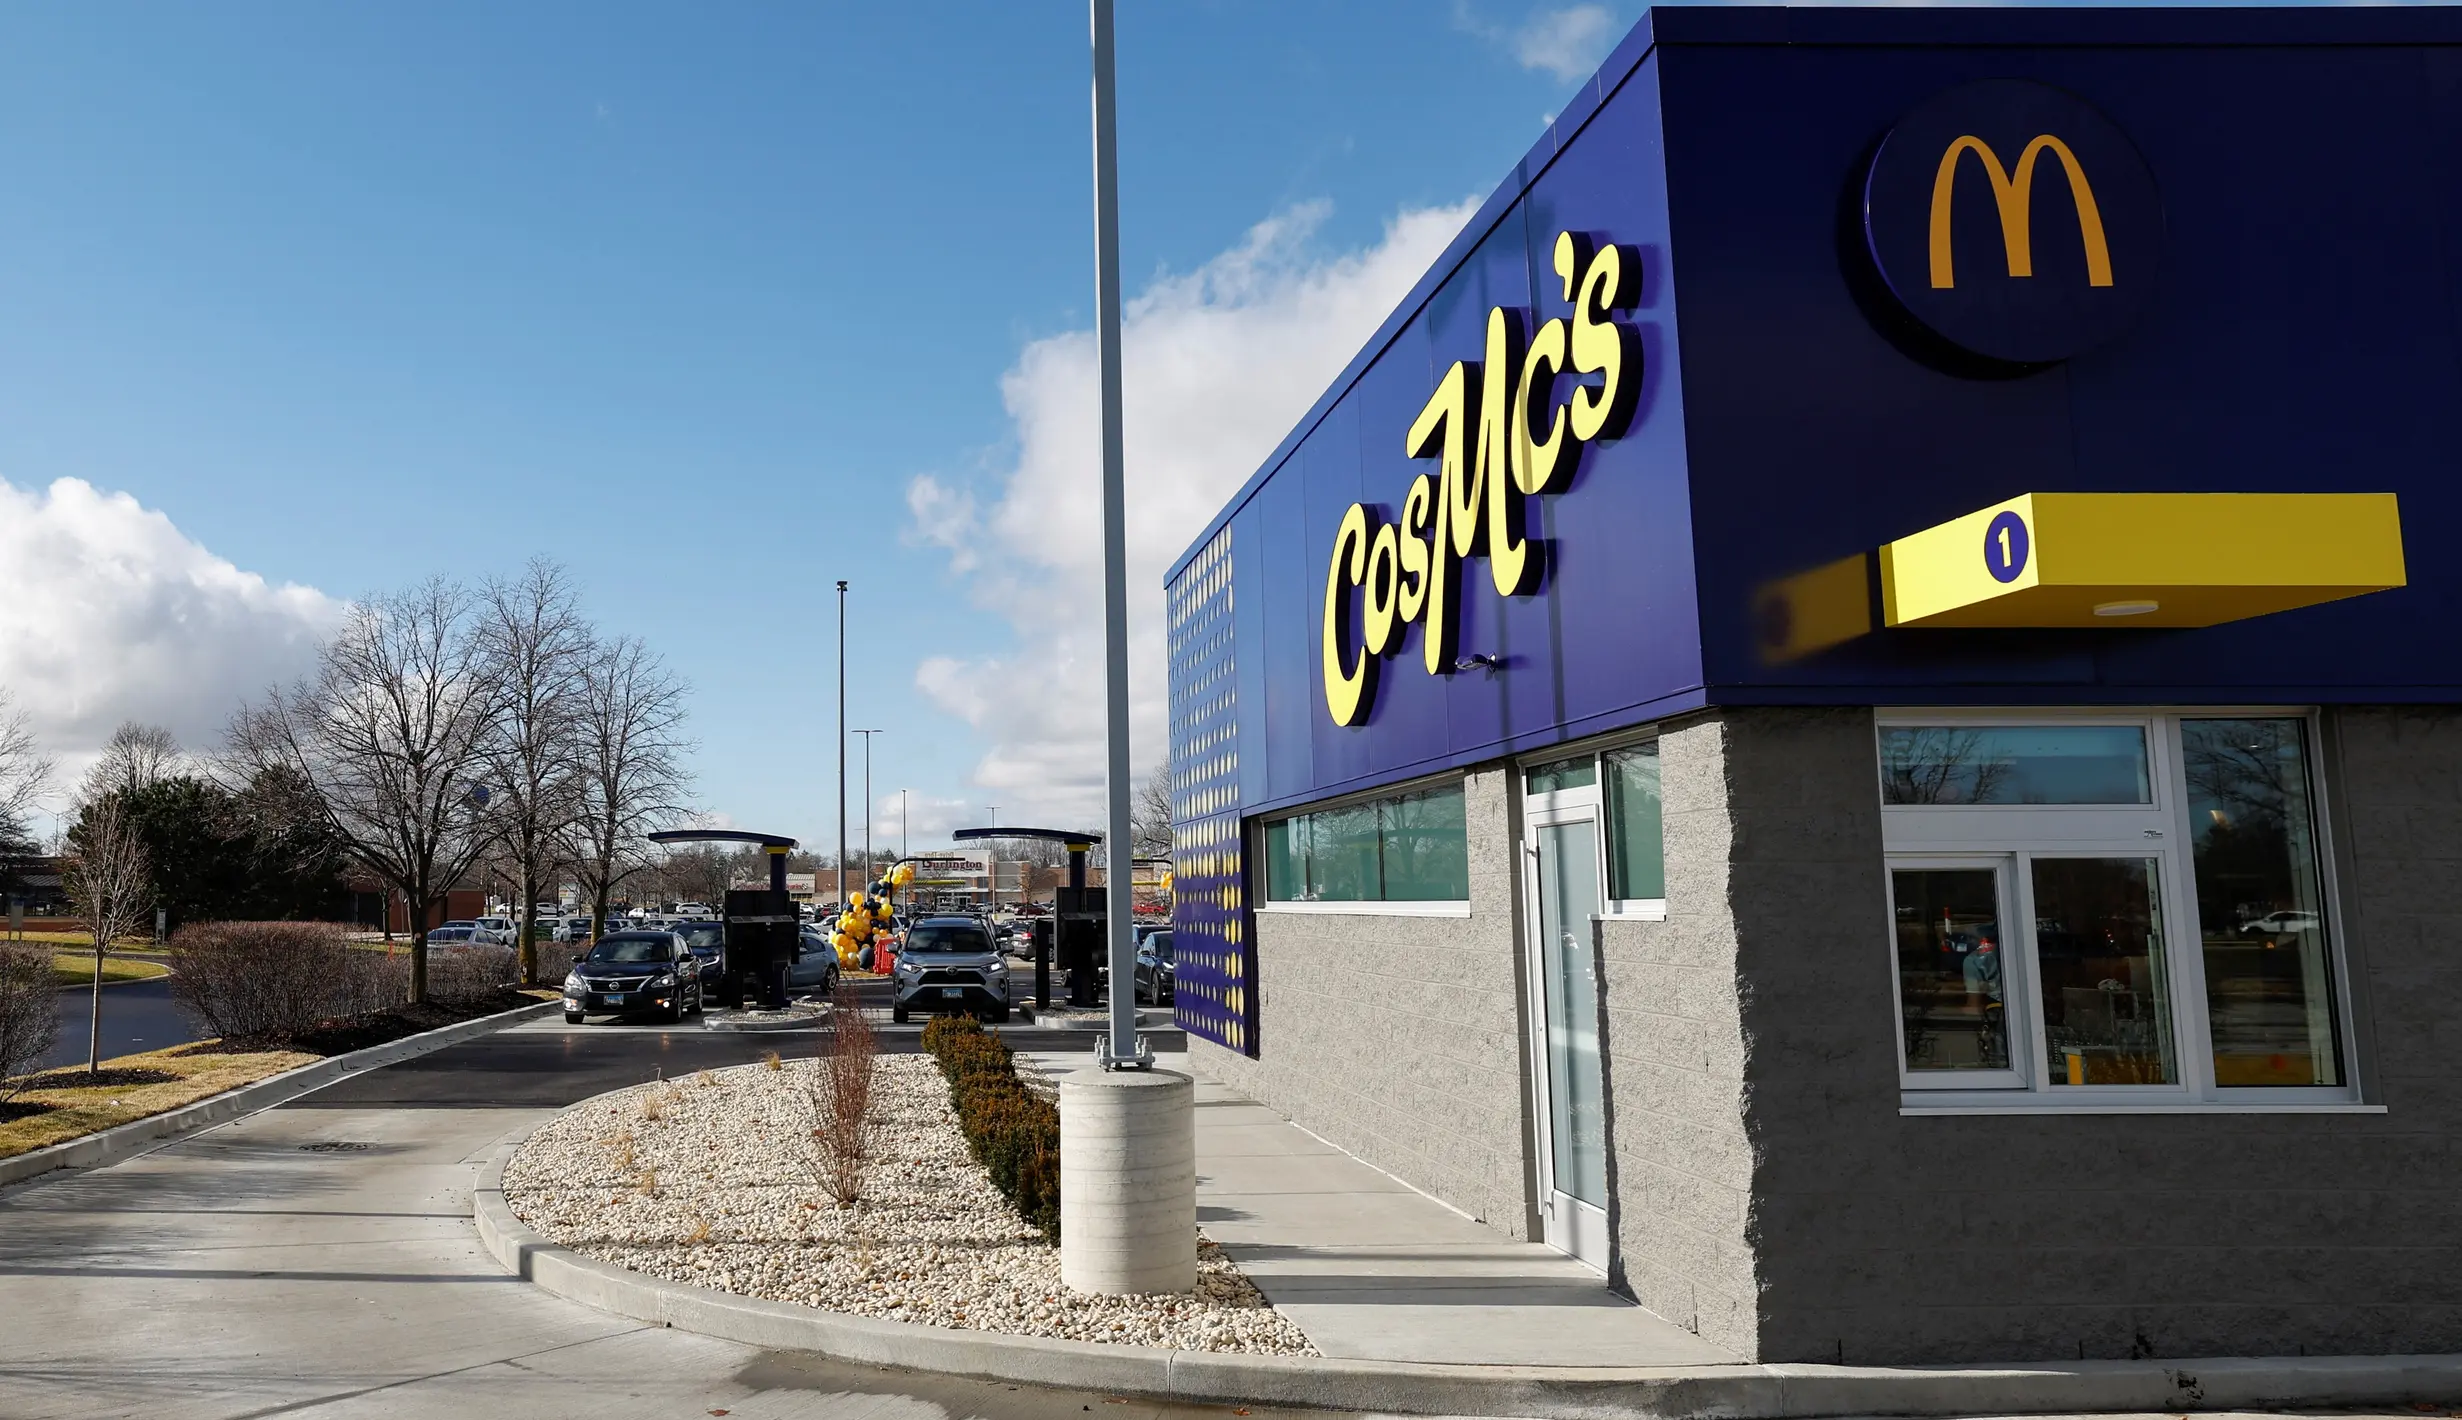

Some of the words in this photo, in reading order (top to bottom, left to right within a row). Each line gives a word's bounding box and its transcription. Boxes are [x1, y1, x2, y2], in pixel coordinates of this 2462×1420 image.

[1929, 134, 2113, 288] M
[1323, 231, 1622, 726] CosMc's
[1998, 526, 2012, 568] 1
